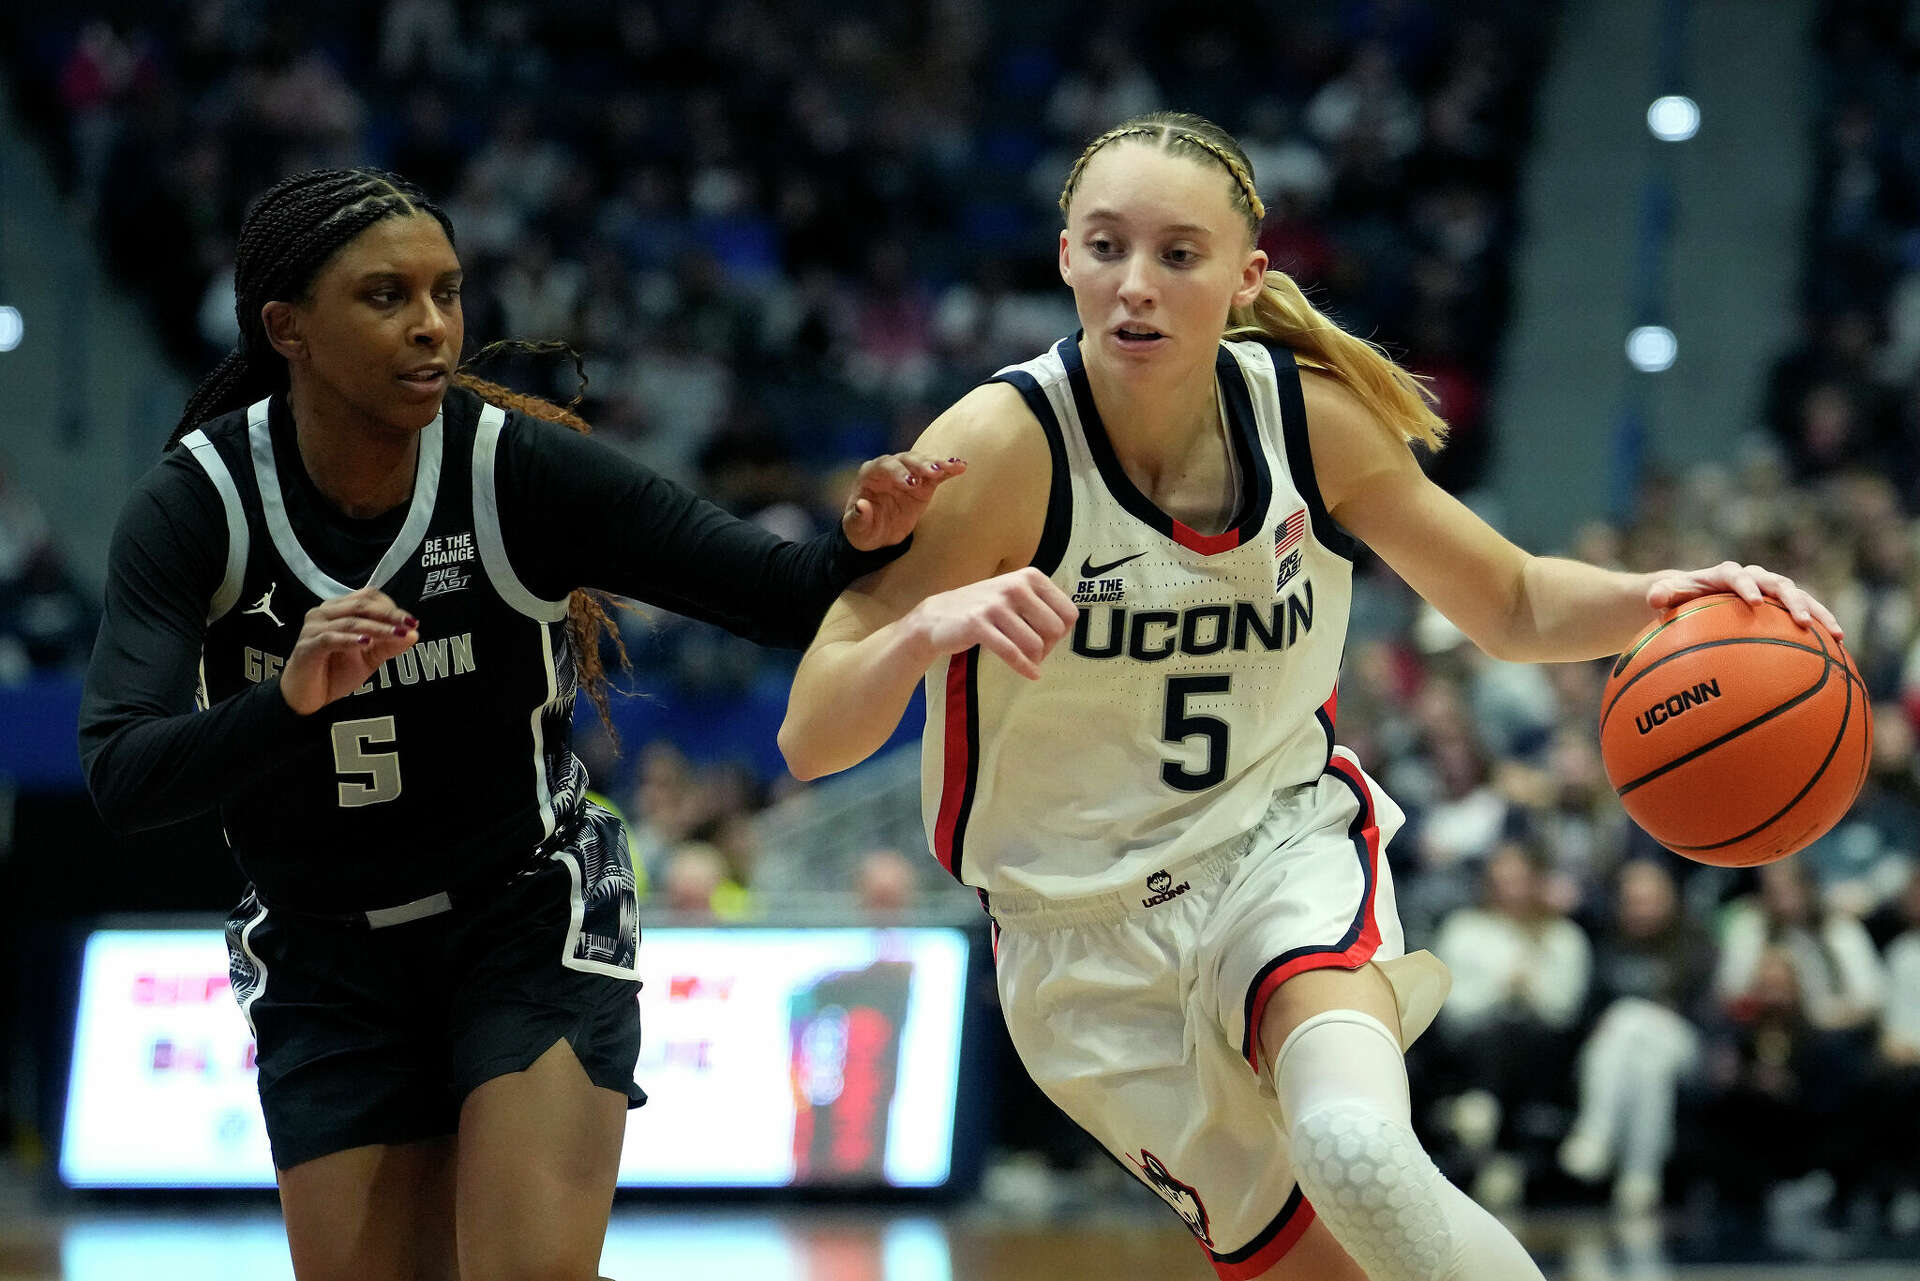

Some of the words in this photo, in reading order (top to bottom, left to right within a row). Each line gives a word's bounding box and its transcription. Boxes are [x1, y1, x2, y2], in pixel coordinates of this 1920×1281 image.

[424, 538, 442, 553] BE
[446, 533, 471, 549] THE
[421, 546, 475, 567] CHANGE
[1280, 548, 1300, 573] BIG
[421, 574, 472, 595] EAST
[426, 566, 461, 584] BIG
[1077, 580, 1096, 594] BE
[1099, 578, 1124, 593] THE
[1070, 591, 1126, 604] CHANGE
[1070, 576, 1314, 662] UCONN
[244, 632, 476, 697] GEOWN
[1635, 678, 1722, 735] UCONN
[1159, 672, 1233, 793] 5
[331, 715, 402, 808] 5
